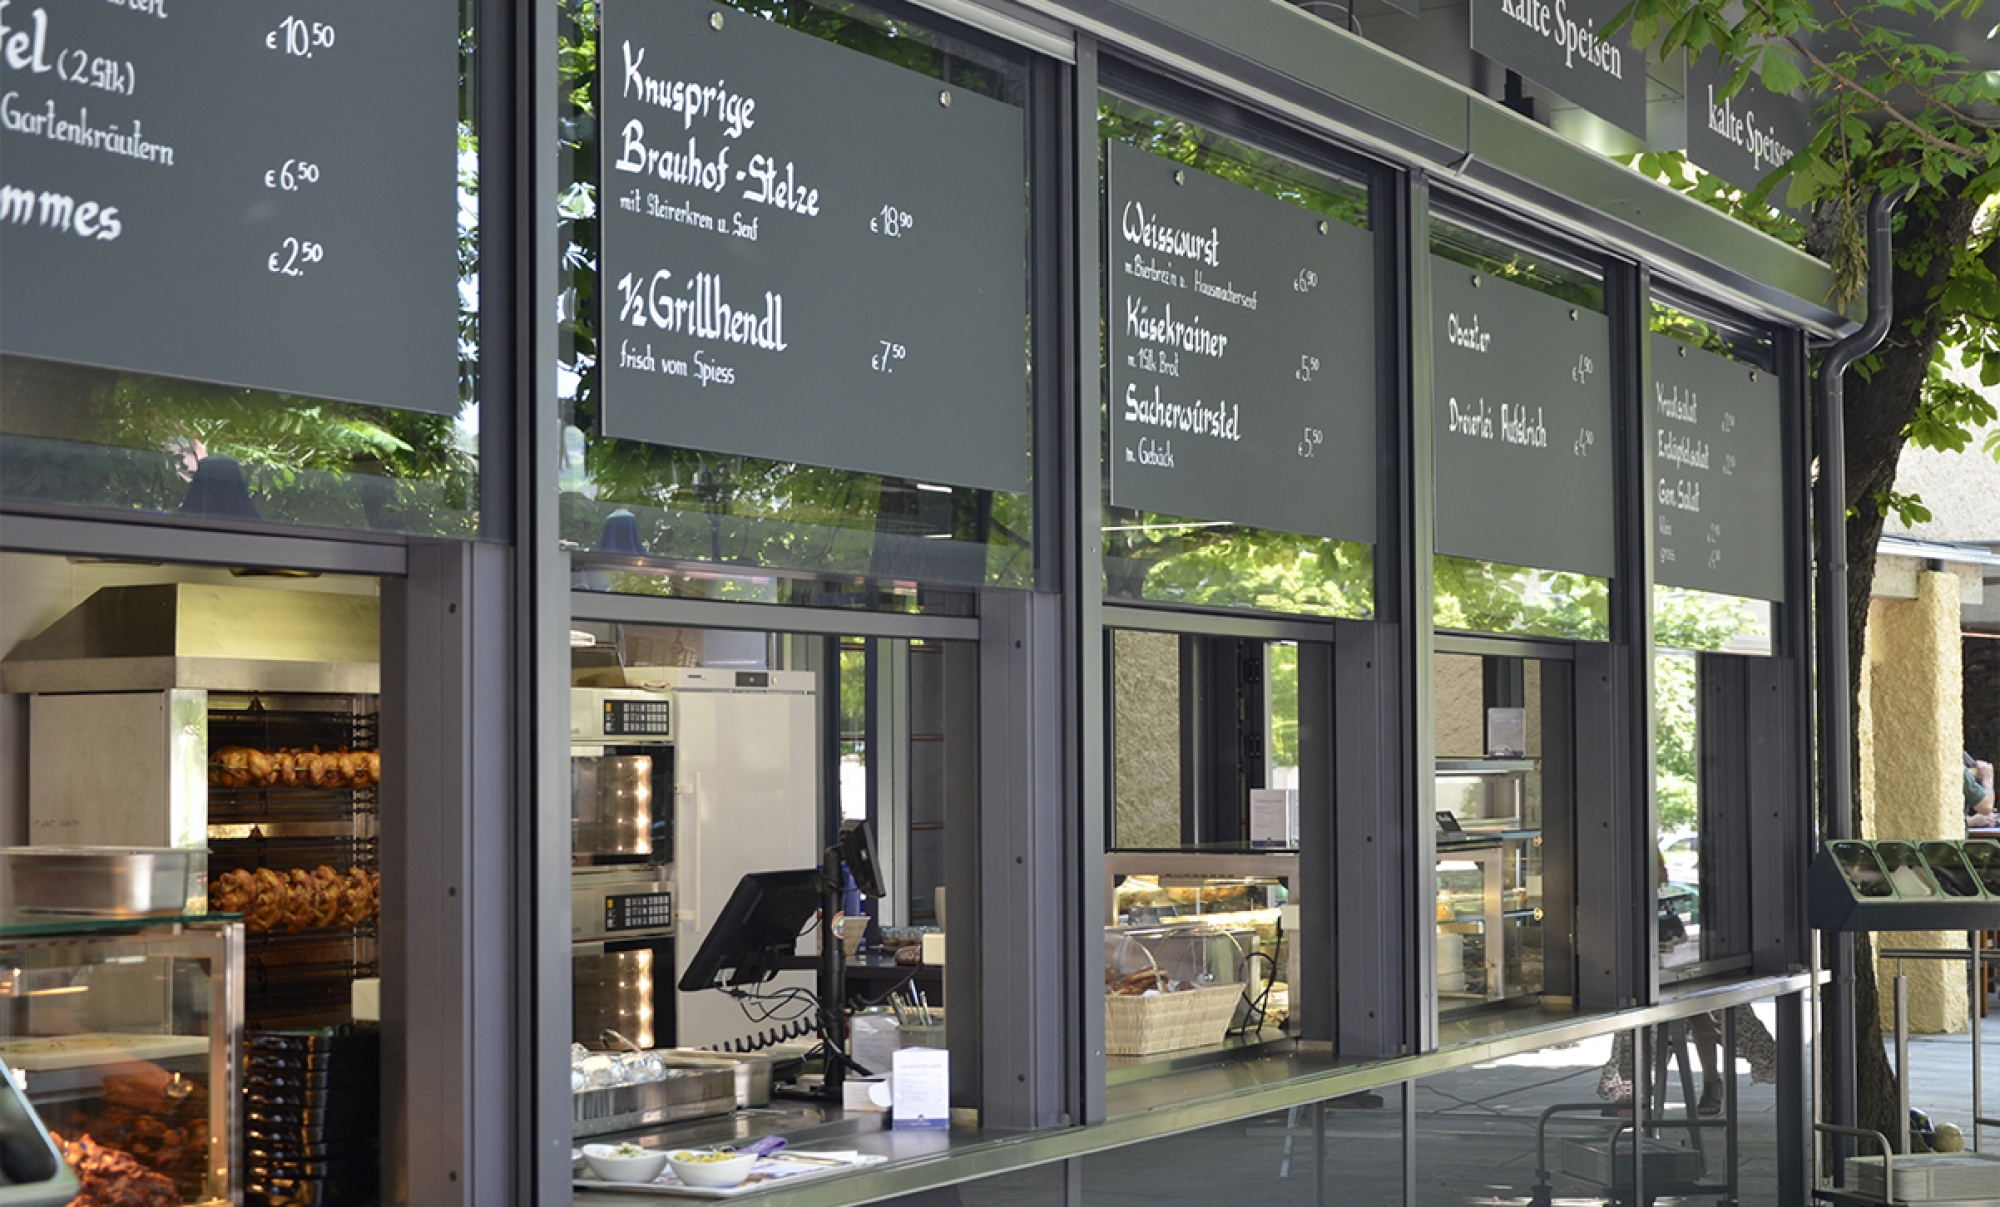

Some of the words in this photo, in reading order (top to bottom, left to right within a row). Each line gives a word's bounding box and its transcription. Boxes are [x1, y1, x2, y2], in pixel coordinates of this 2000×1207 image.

[266, 16, 335, 58] €10.50
[1501, 0, 1550, 37] alte
[1554, 0, 1622, 79] Speisen
[622, 40, 755, 138] Knusprige
[1, 91, 174, 166] Gartenkräutern
[1709, 85, 1743, 145] kalte
[265, 159, 319, 191] €6.50
[615, 118, 729, 193] Brauhof
[620, 189, 641, 212] mit
[647, 193, 712, 230] Steirerkren
[718, 219, 729, 233] u.
[732, 211, 758, 241] Senf
[870, 205, 912, 237] €18.90
[1123, 201, 1219, 267] Weisswurst
[268, 237, 323, 276] €2.50
[1195, 269, 1257, 309] Hausmachersenf
[1127, 296, 1228, 358] Käsekrainer
[620, 339, 655, 371] frisch
[662, 359, 687, 376] vom
[694, 351, 734, 387] Spiess
[872, 341, 905, 372] €7.50
[1159, 351, 1178, 376] Brot
[1125, 383, 1241, 441] Sacherwürstel
[1449, 398, 1493, 439] Dreierlei
[1501, 404, 1547, 447] Aufstrich
[1138, 437, 1175, 467] Gebäck
